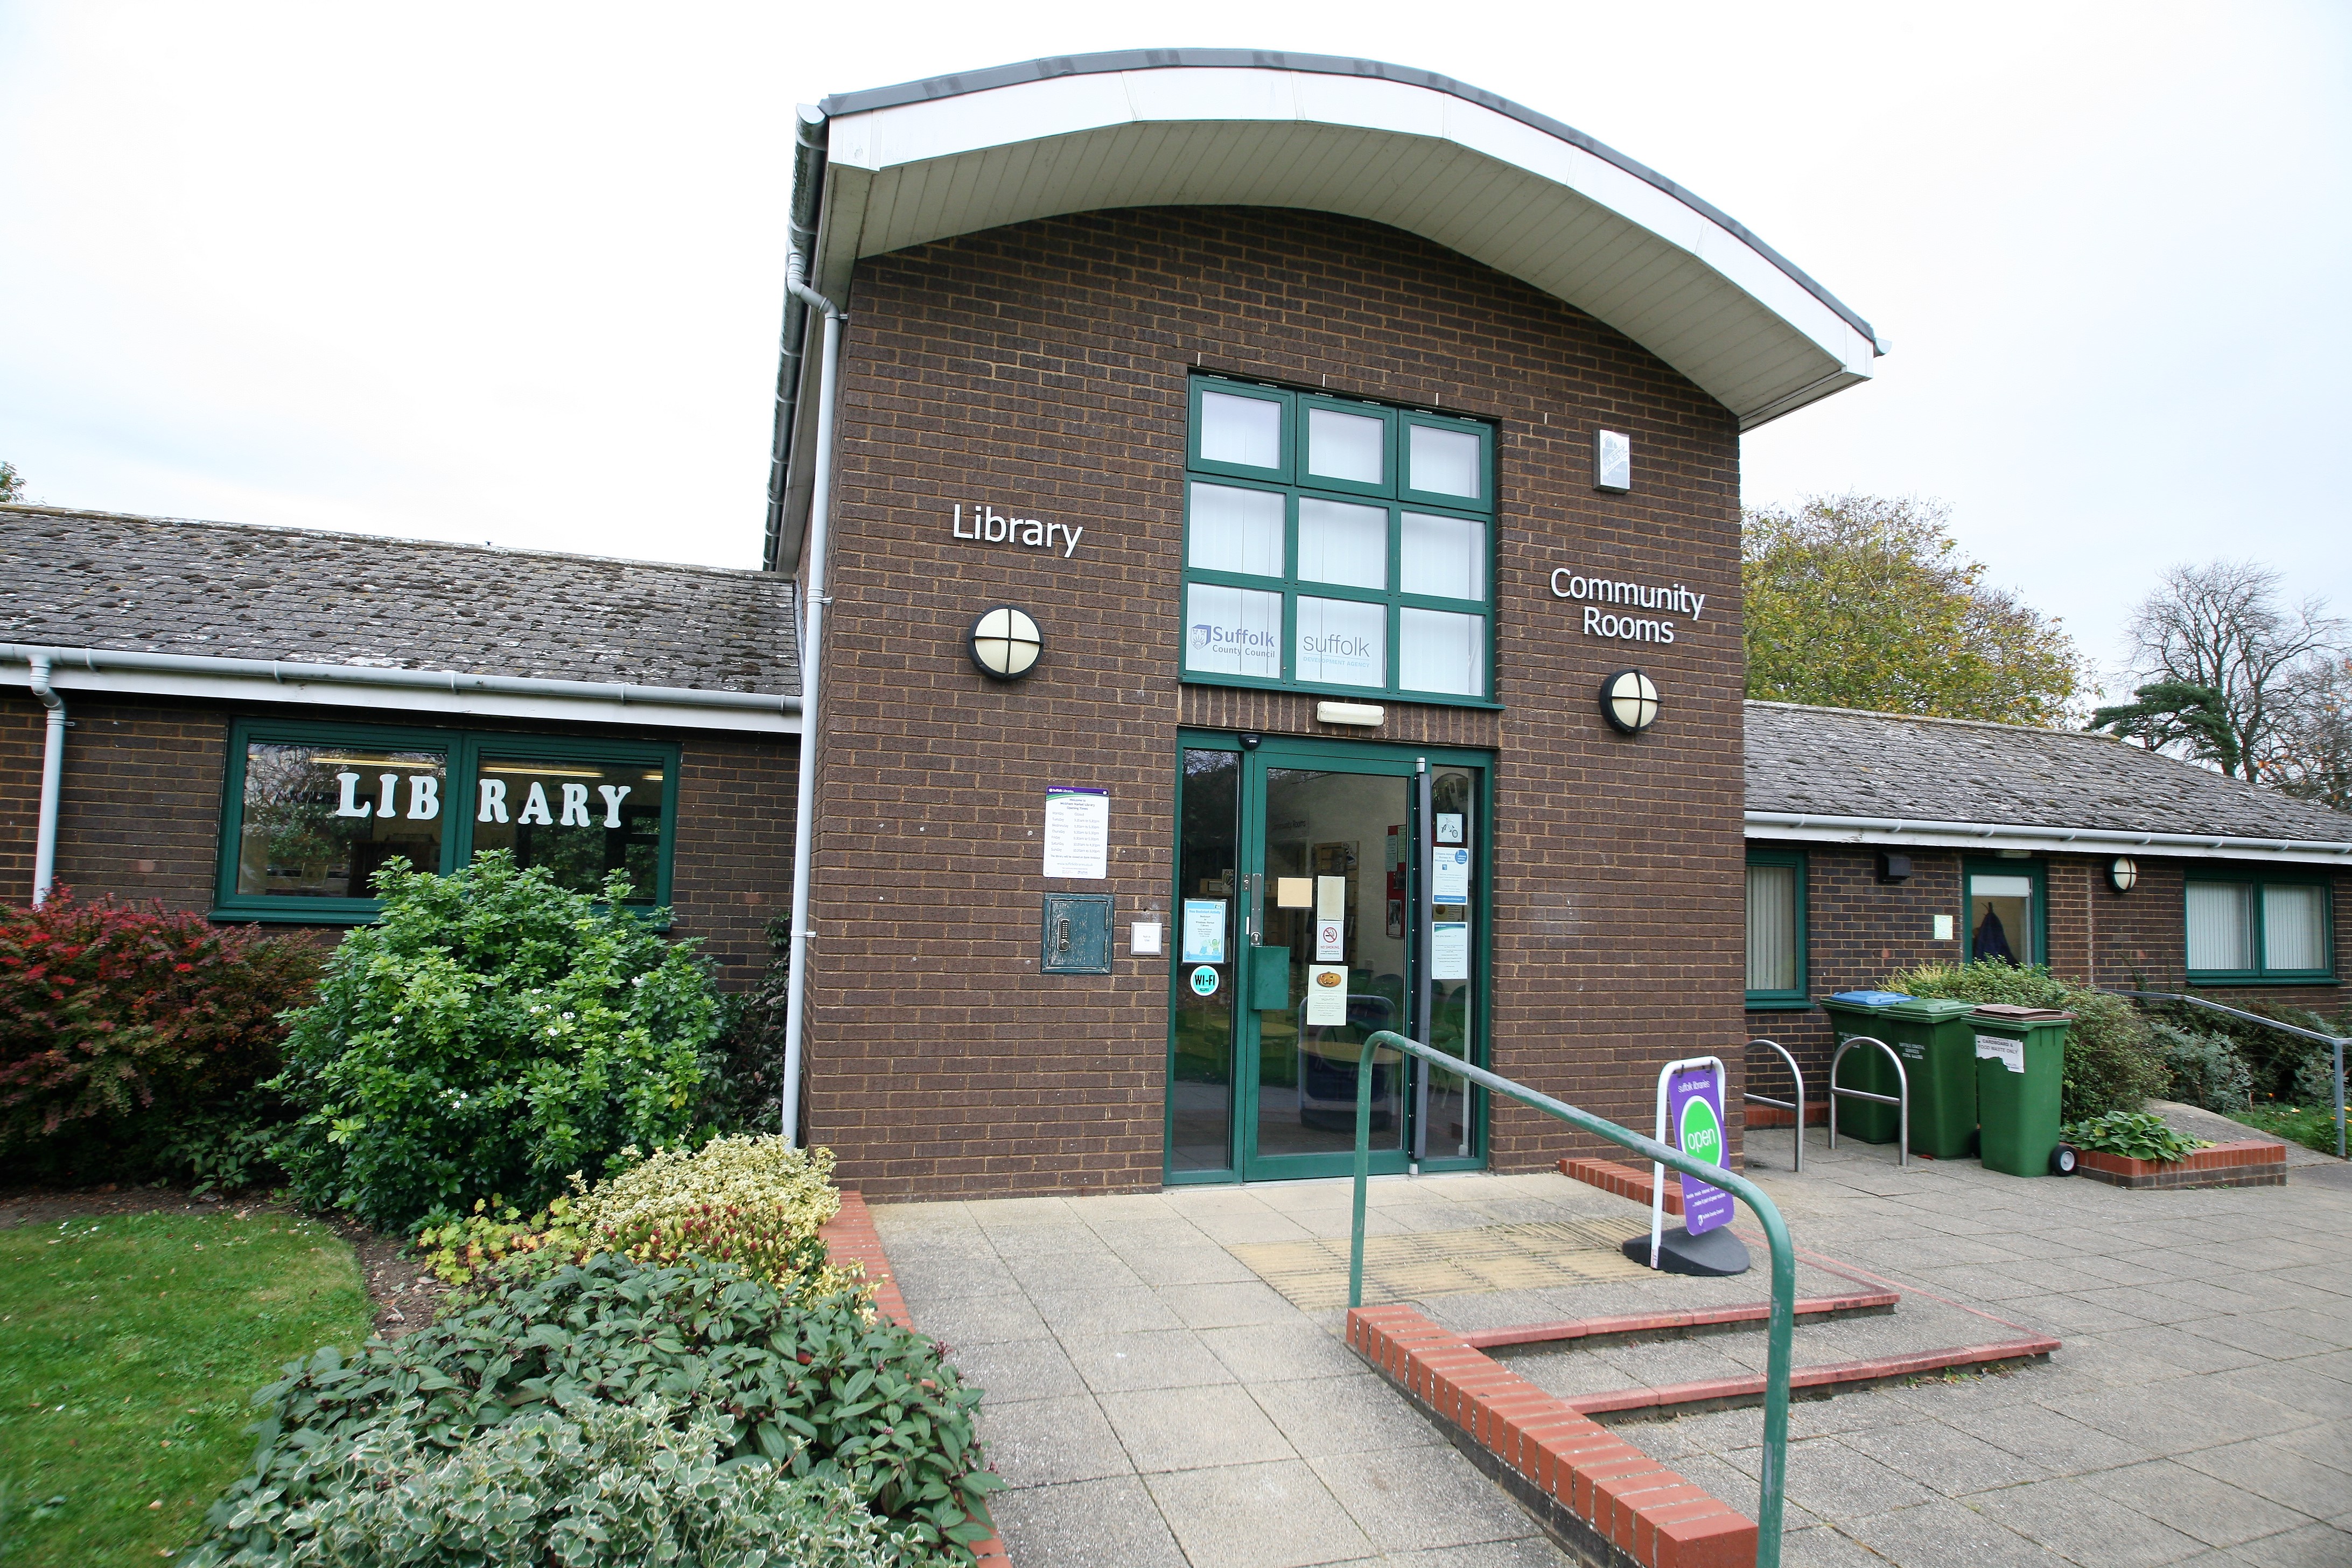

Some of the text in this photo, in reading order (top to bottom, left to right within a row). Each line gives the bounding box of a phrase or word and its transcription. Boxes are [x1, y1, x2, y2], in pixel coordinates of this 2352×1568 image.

[953, 504, 1083, 558] Library
[1550, 568, 1706, 620] Community
[1584, 606, 1675, 643] Rooms
[1213, 626, 1275, 647] Suffolk
[1303, 634, 1370, 657] suffolk
[1213, 645, 1275, 658] County Council
[1303, 656, 1370, 668] DEVELOPMENT AGENCY
[335, 772, 631, 828] LIBRARY
[1194, 975, 1215, 986] WI-FI
[1677, 1080, 1711, 1094] suffolk libraries
[1688, 1128, 1716, 1153] open
